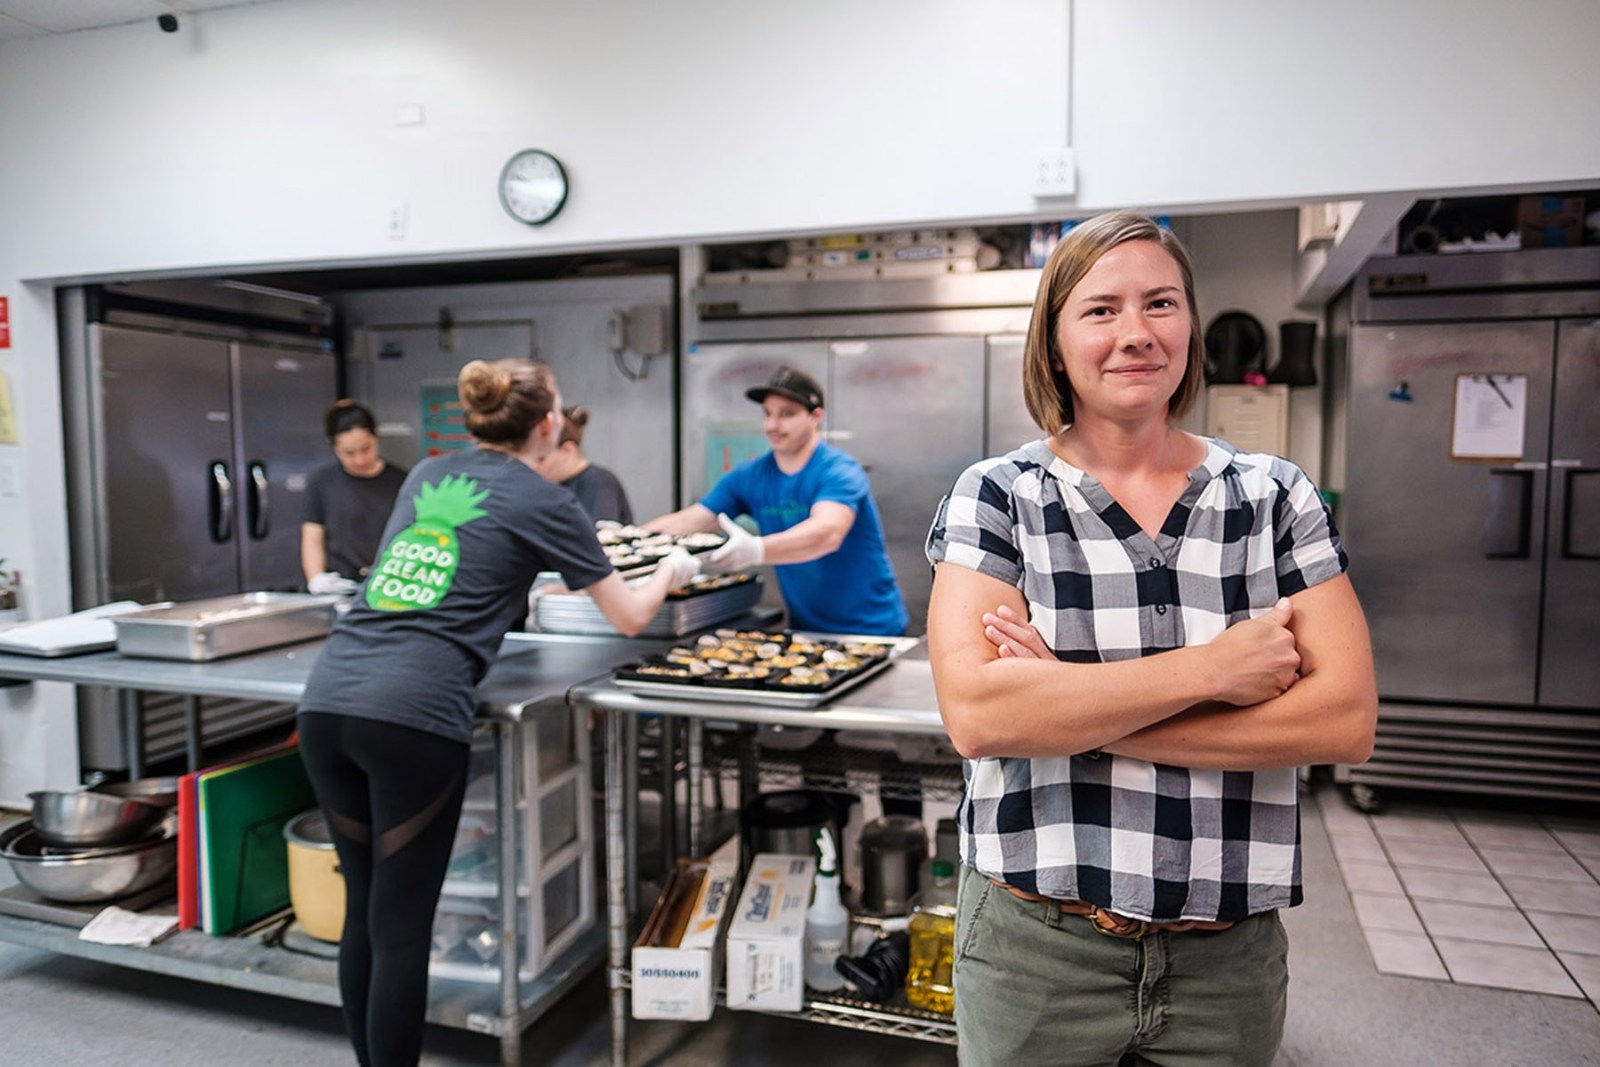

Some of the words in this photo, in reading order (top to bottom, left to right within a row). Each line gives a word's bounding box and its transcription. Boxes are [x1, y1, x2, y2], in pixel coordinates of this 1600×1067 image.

[391, 541, 453, 567] GOOD
[382, 558, 447, 587] CLEAN
[370, 574, 436, 605] FOOD
